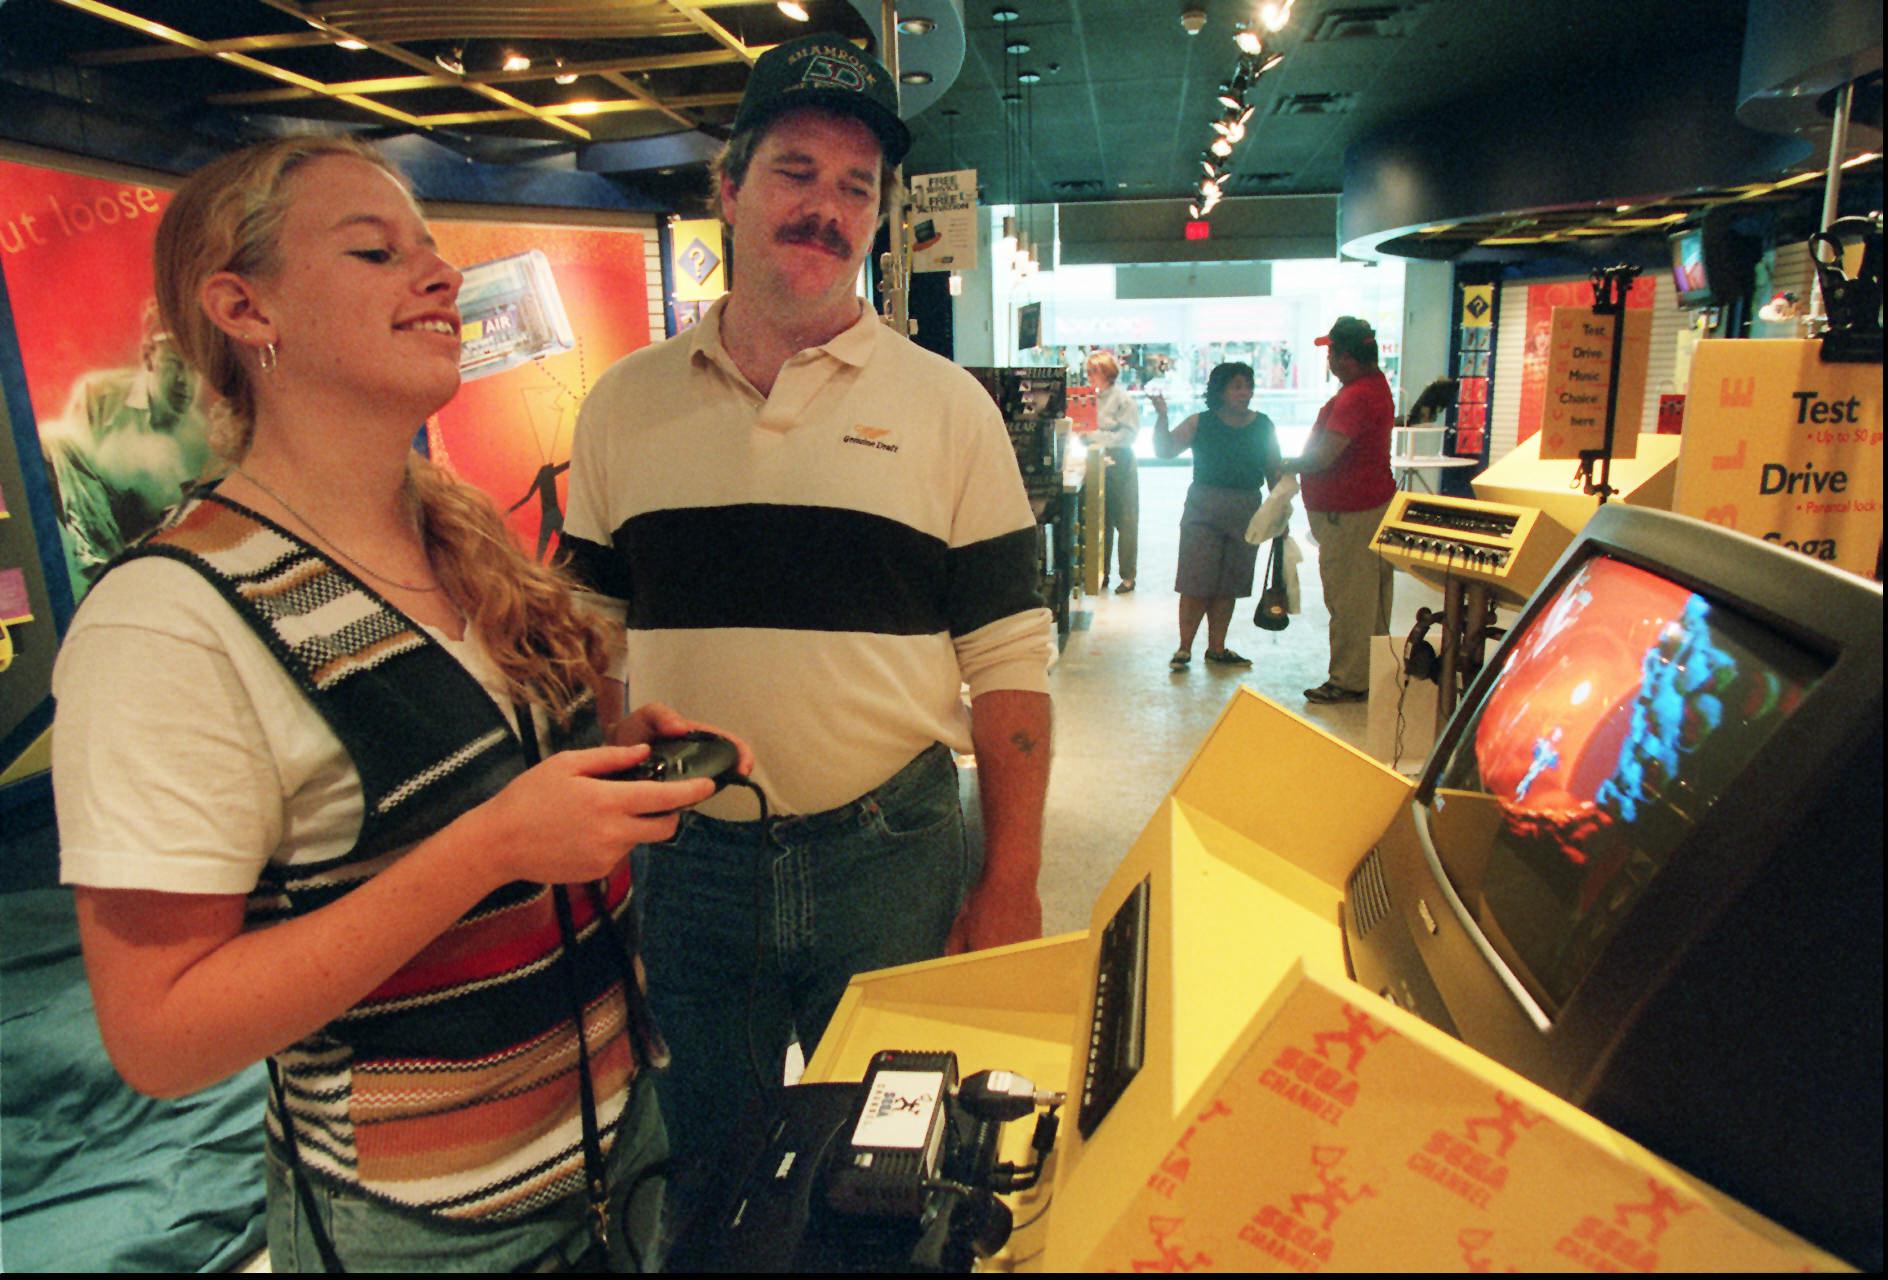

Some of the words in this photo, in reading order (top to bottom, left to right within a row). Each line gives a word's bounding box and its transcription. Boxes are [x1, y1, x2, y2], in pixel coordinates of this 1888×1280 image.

[928, 175, 957, 187] FREE
[49, 186, 160, 237] loose
[928, 194, 957, 206] FREE
[486, 315, 512, 335] AIR
[1582, 324, 1606, 336] Test
[1572, 347, 1603, 358] Drive
[1568, 370, 1600, 382] Music
[1559, 392, 1599, 404] Choice
[1792, 391, 1861, 425] Test
[1571, 416, 1596, 427] here
[1759, 462, 1848, 495] Drive
[1273, 1045, 1360, 1108] SEGA
[1257, 1068, 1345, 1127] CHANNEL
[1423, 1130, 1509, 1192] SEGA
[1406, 1152, 1493, 1211] CHANNEL
[1252, 1203, 1335, 1264] SEGA
